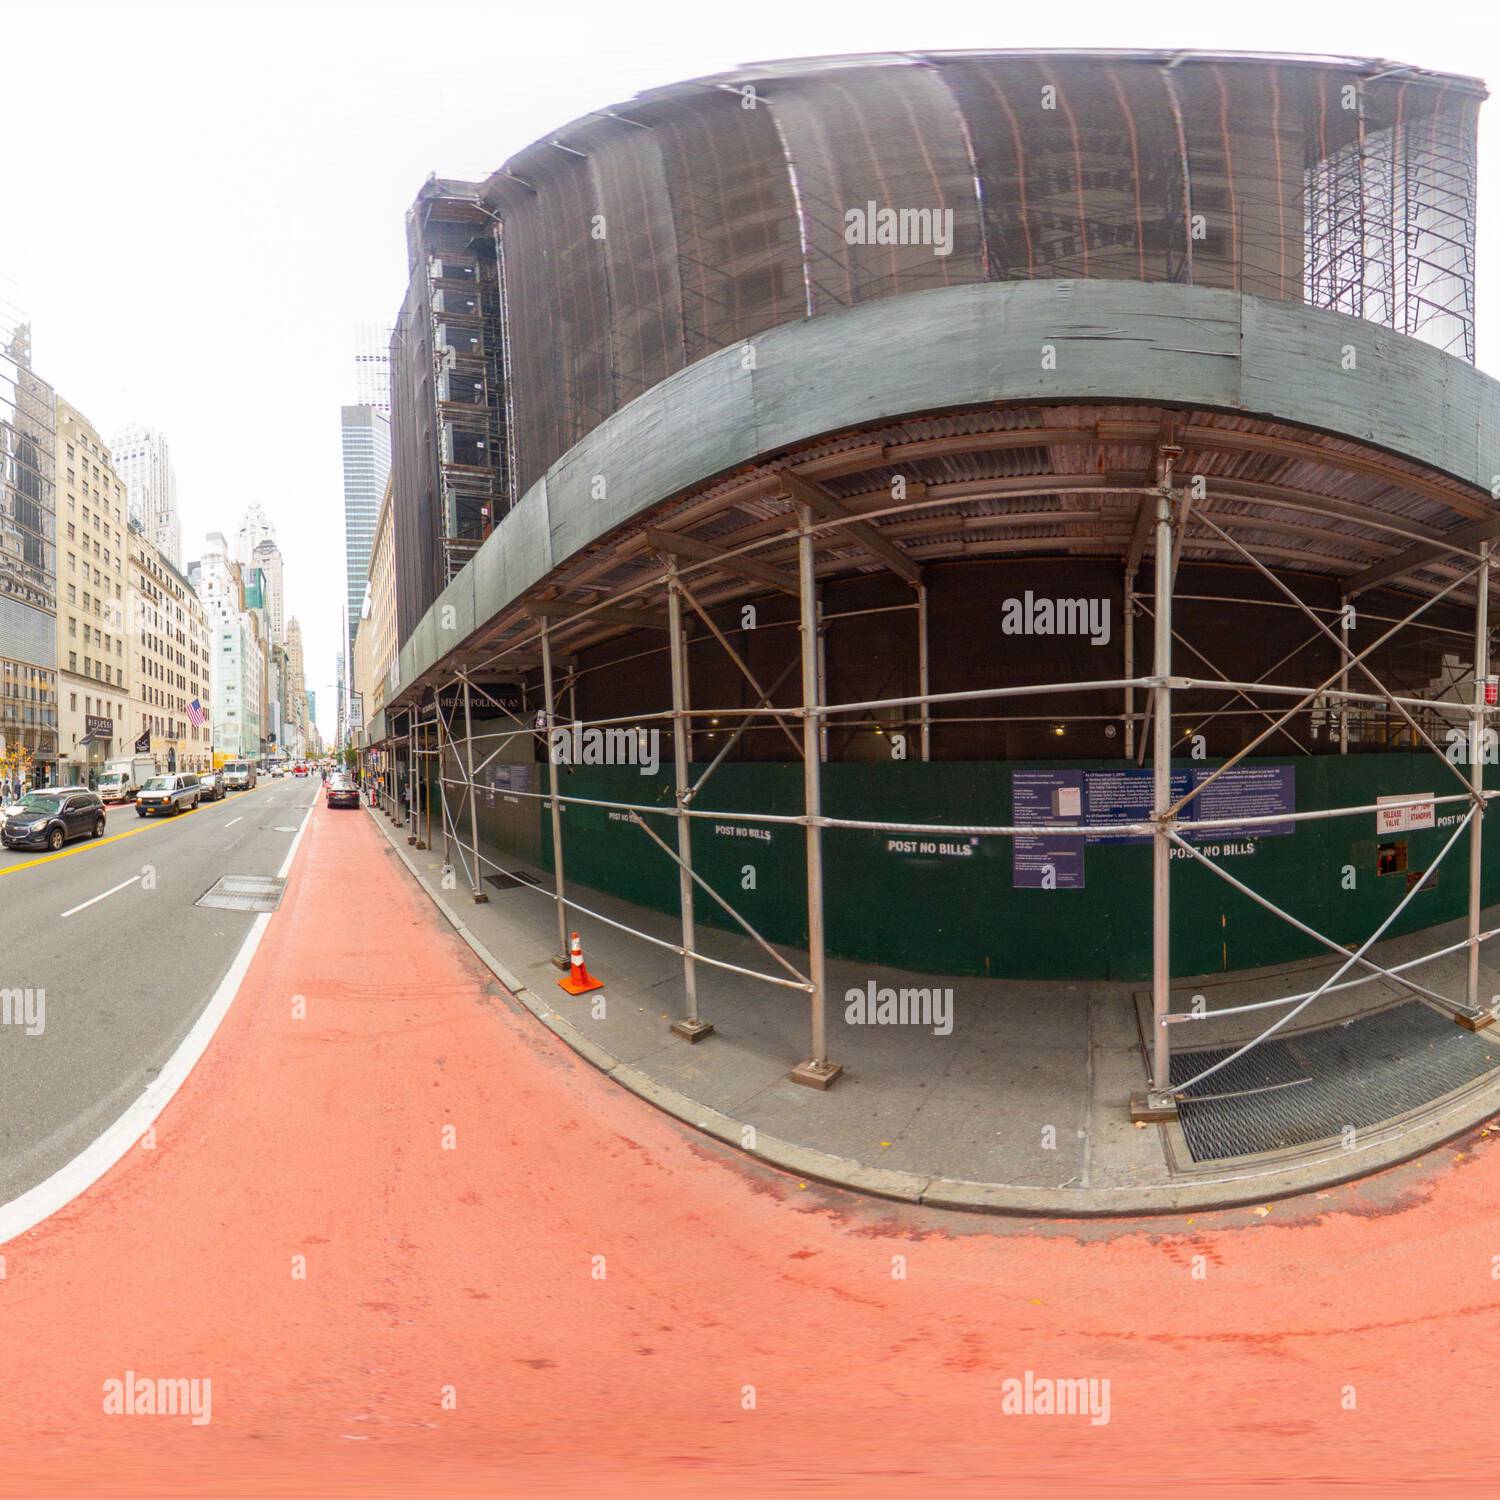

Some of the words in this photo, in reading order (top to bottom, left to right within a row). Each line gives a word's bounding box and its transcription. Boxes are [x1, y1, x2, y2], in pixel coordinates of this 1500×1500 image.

[1383, 809, 1402, 819] RELEASE
[1385, 818, 1400, 828] VALVE
[1437, 816, 1455, 827] POST
[715, 824, 734, 836] POST
[736, 827, 747, 838] NO
[749, 829, 771, 841] BILLS
[887, 840, 918, 852] POST
[920, 842, 936, 854] NO
[939, 843, 972, 856] BILLS
[1203, 845, 1220, 857] NO
[1223, 843, 1255, 856] BILLS
